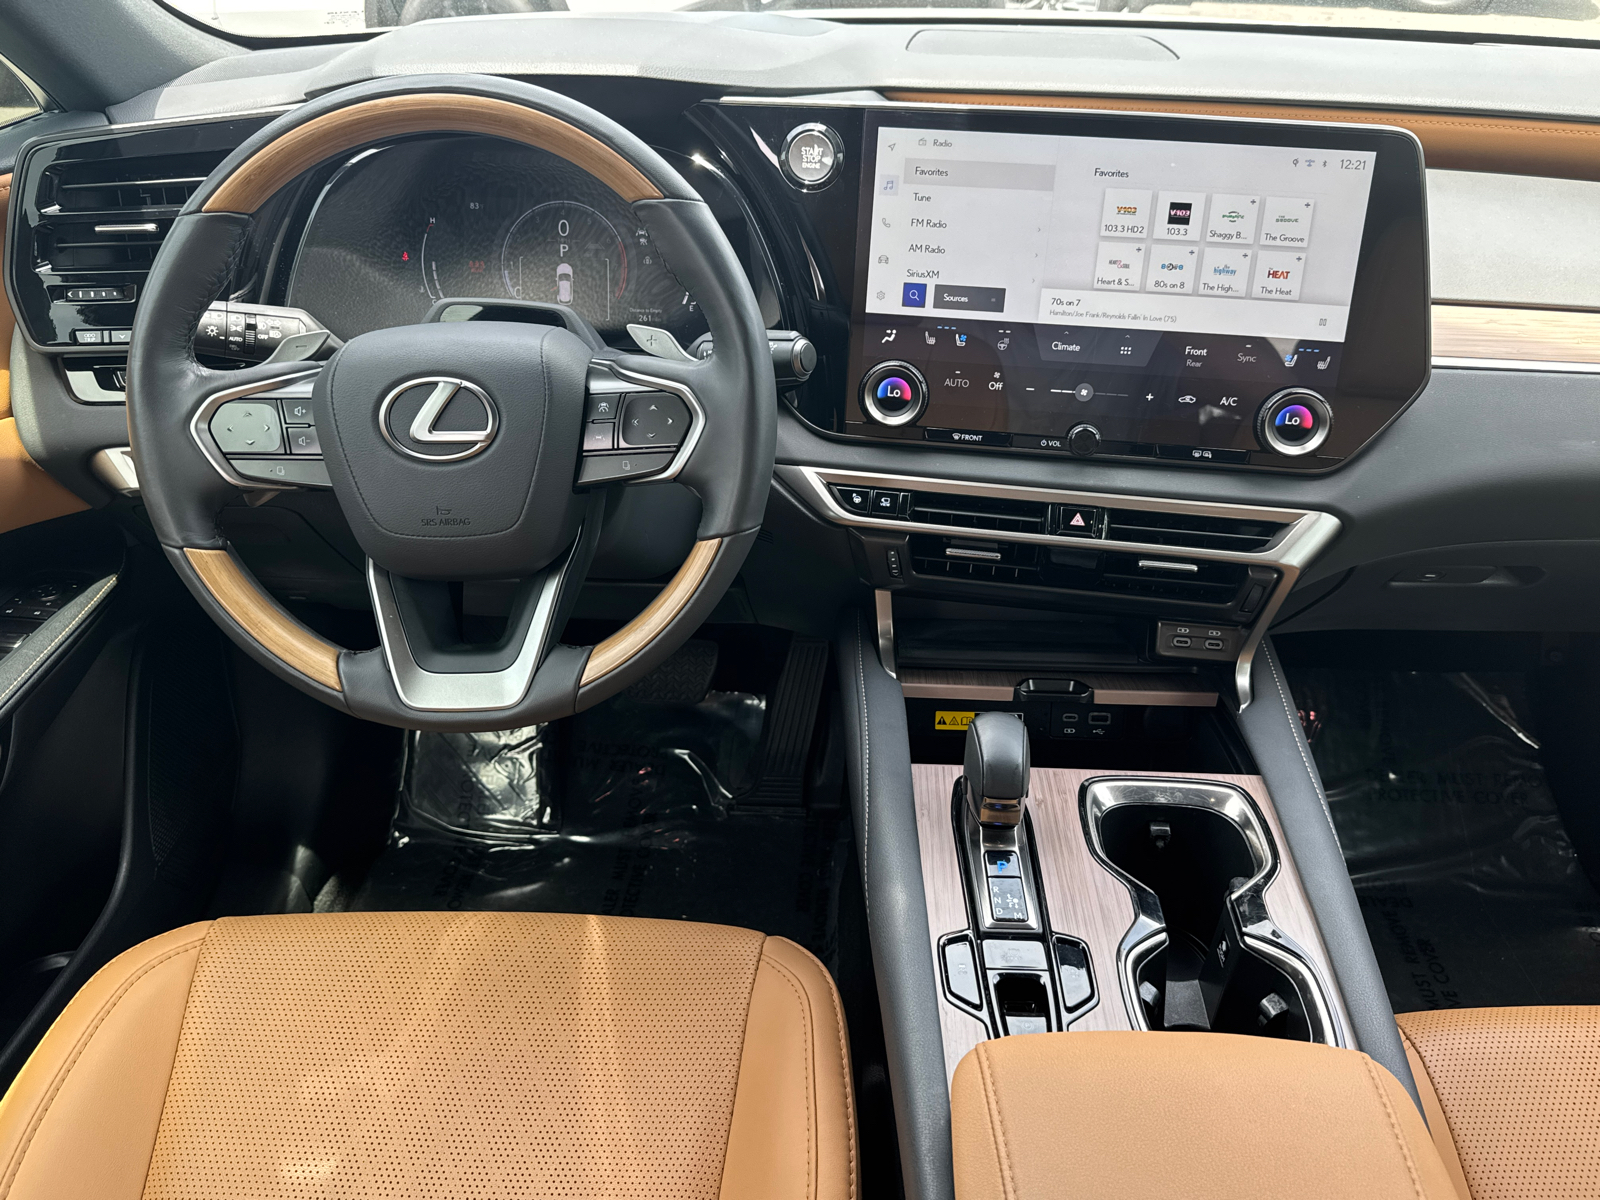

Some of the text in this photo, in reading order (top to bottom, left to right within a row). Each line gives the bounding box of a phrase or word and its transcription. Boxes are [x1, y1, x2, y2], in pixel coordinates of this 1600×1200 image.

[932, 139, 953, 149] Radio
[802, 155, 821, 163] STOP
[1339, 159, 1367, 171] 12:21
[914, 166, 949, 178] Favorites
[1094, 167, 1130, 179] Favorites
[913, 192, 932, 202] Tune
[910, 218, 948, 229] FM Radio
[1104, 224, 1145, 234] 103.3 HD2
[1166, 227, 1188, 236] 103.3
[1209, 230, 1234, 240] Shaggy
[1264, 233, 1305, 243] The Groove
[559, 244, 569, 257] P
[908, 244, 946, 255] AM Radio
[906, 269, 940, 279] SiriusXM
[1213, 266, 1237, 276] highway
[1267, 270, 1291, 279] HEAT
[1096, 277, 1116, 285] Heart
[1116, 278, 1123, 286] &
[1153, 280, 1168, 288] 80s
[1202, 283, 1215, 291] The
[1260, 286, 1292, 296] The Heat
[943, 294, 969, 303] Sources
[1051, 298, 1065, 306] 70s
[1075, 299, 1081, 307] 7
[638, 314, 652, 322] 261
[1049, 309, 1084, 318] Hamilton/Joe
[1085, 311, 1127, 320] Frank/Reynolds
[1163, 315, 1178, 323] (75)
[1051, 341, 1081, 352] Climate
[1184, 346, 1208, 357] Front
[1186, 359, 1203, 368] Rear
[1236, 353, 1257, 364] Sync
[943, 378, 970, 388] AUTO
[988, 381, 1003, 391] Off
[886, 385, 901, 398] Lo
[1219, 396, 1238, 406] A/C
[1285, 412, 1300, 426] Lo
[961, 433, 983, 442] FRONT
[421, 518, 471, 526] SRS AIRBAG
[997, 861, 1008, 873] P
[994, 896, 1001, 904] N
[1014, 912, 1022, 920] M
